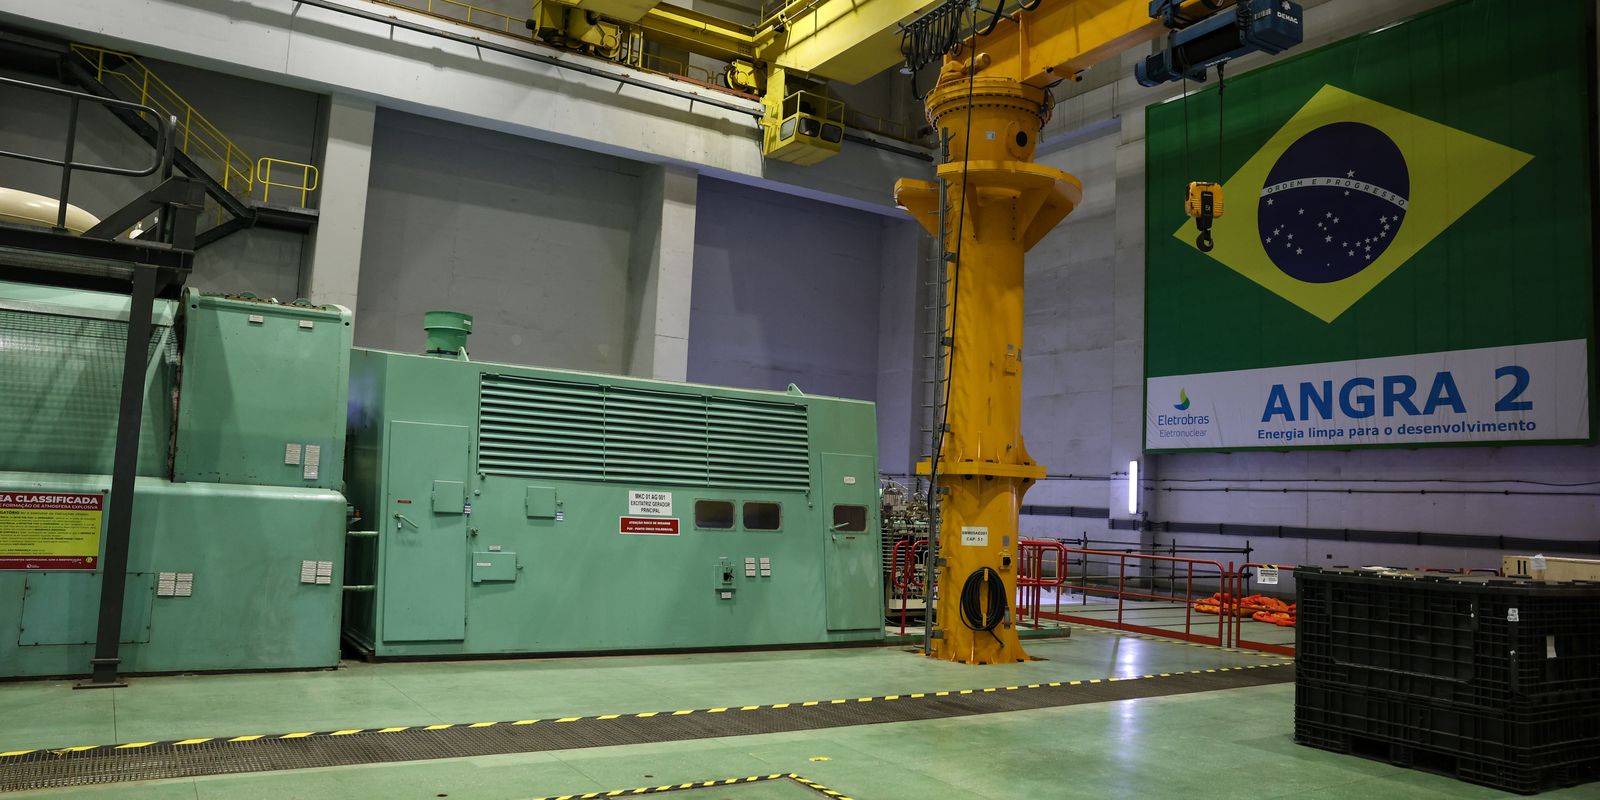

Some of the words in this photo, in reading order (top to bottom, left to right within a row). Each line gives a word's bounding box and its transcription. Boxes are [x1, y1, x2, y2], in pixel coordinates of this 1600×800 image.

[1276, 11, 1299, 24] DEMAG
[1267, 180, 1303, 194] ORDEM
[1326, 178, 1405, 207] PROGRESSO
[1260, 371, 1467, 422] ANGRA
[1494, 365, 1533, 412] 2
[1158, 414, 1210, 426] Eletrobras
[1159, 428, 1207, 438] Eletronuclear
[1257, 428, 1304, 441] Energia
[1308, 427, 1344, 440] limpa
[1349, 426, 1380, 439] para
[1384, 426, 1393, 436] o
[1397, 420, 1537, 435] desenvolvimento
[15, 495, 98, 504] CLASSIFICADA
